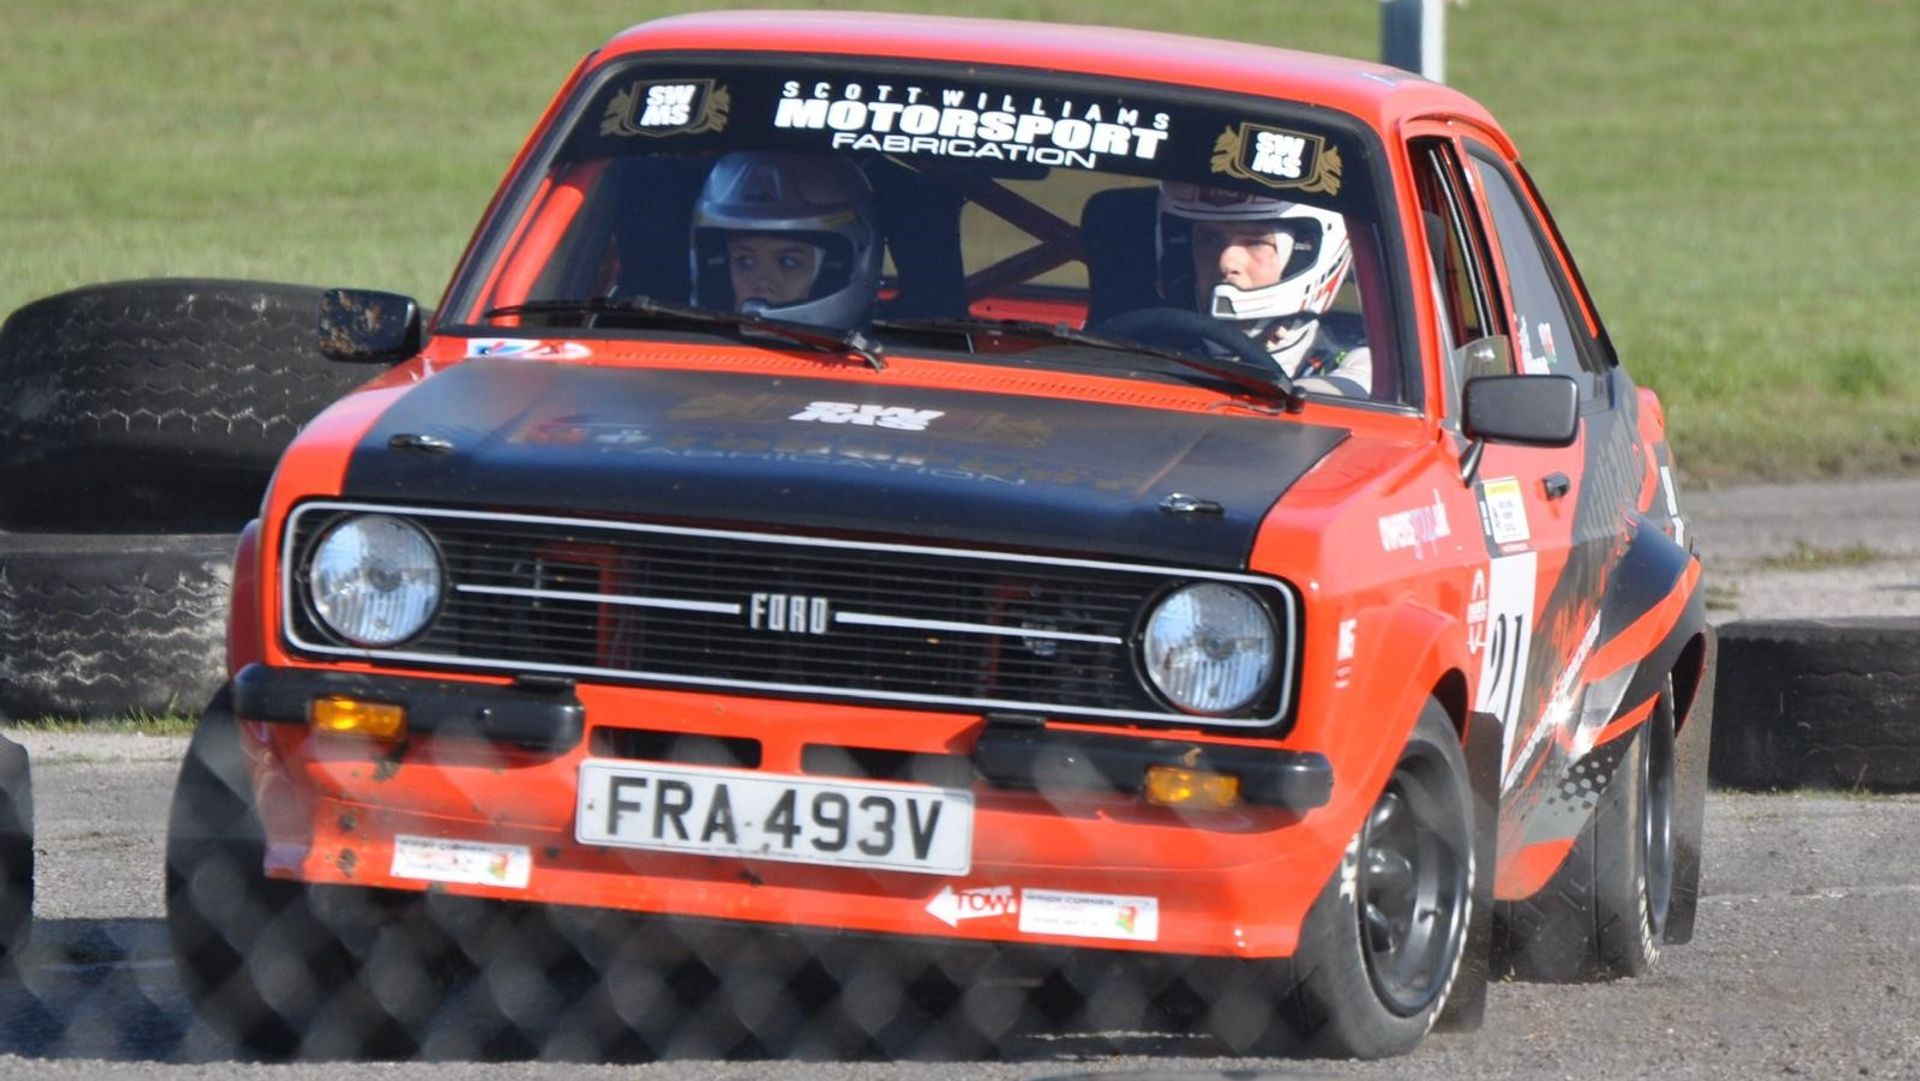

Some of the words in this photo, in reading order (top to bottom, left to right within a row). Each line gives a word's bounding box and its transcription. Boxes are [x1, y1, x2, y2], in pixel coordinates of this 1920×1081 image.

[647, 84, 697, 107] SW
[781, 80, 929, 104] SCOTT
[941, 88, 1170, 131] WILLIAMS
[640, 103, 691, 127] MS
[774, 98, 1169, 160] MOTORSPORT
[831, 132, 1096, 169] FABRICATION
[1255, 131, 1306, 155] SW
[1250, 150, 1302, 179] MS
[749, 592, 829, 635] FORD
[605, 775, 738, 845] FRA
[762, 788, 944, 861] 493V
[958, 891, 1015, 913] TOW
